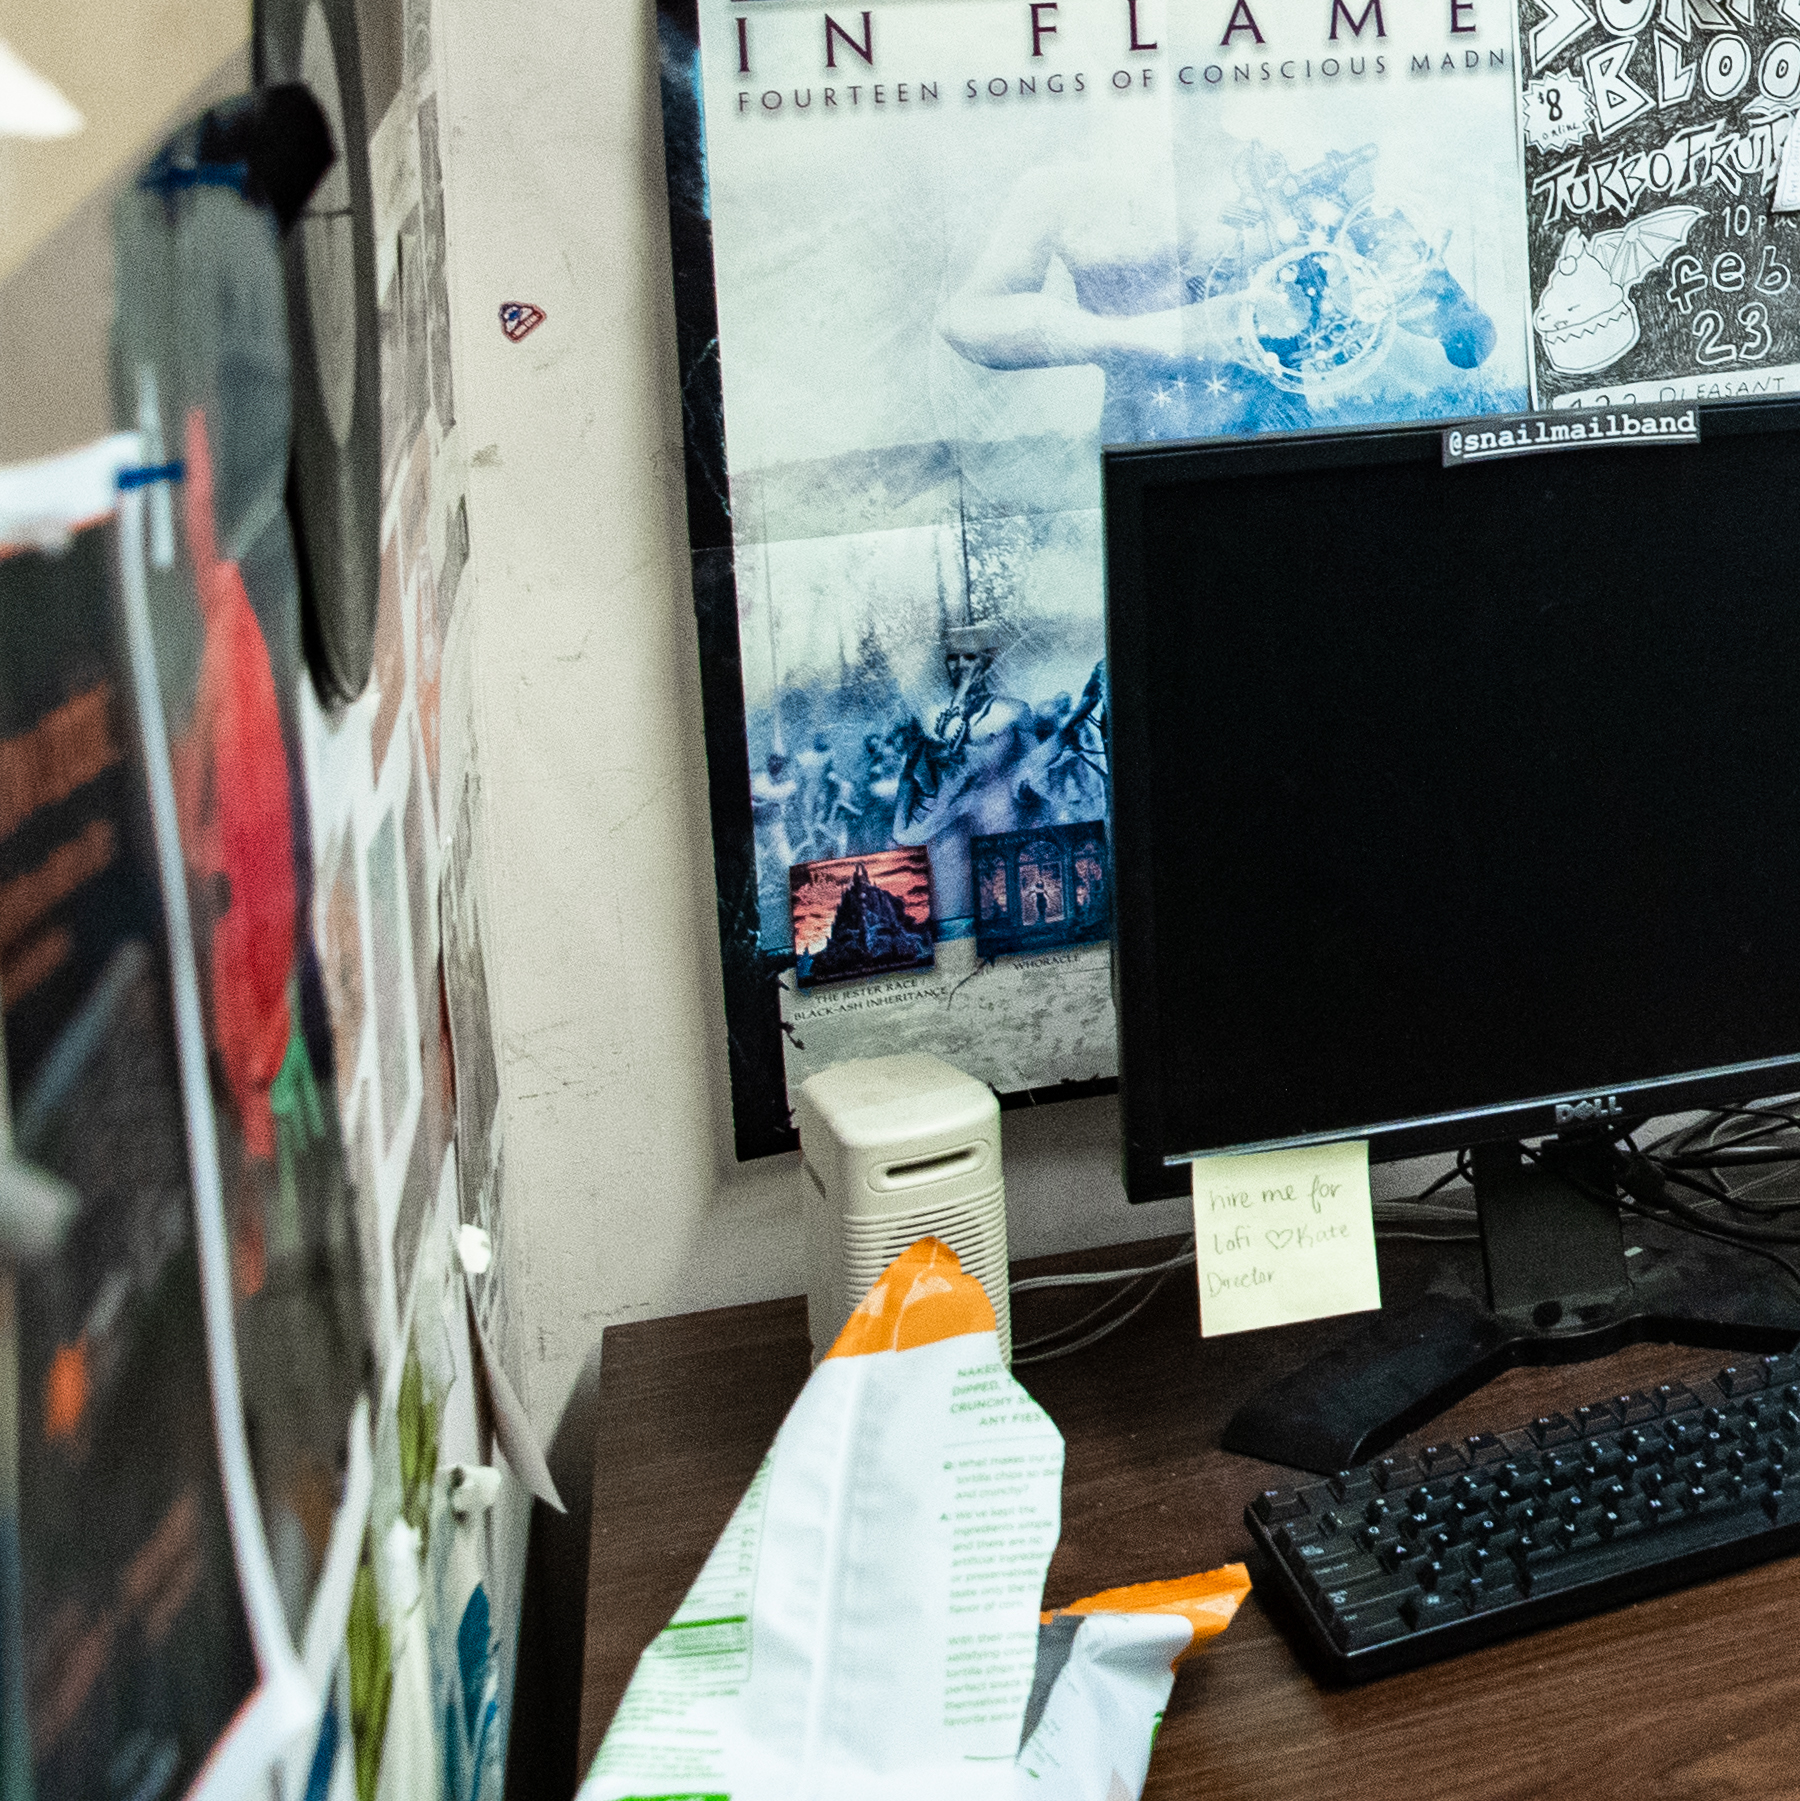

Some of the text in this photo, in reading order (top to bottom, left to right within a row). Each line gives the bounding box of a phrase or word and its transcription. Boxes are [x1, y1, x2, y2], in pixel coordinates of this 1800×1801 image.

[734, 10, 874, 74] IN
[737, 54, 1387, 114] FOURTEEN SONGS OF CONSCIOUS
[1721, 205, 1751, 238] 10
[1669, 247, 1791, 316] feb
[1693, 302, 1773, 366] 23
[1447, 409, 1698, 462] @snailmailband
[1555, 1096, 1623, 1126] DELL
[1209, 1174, 1342, 1214] hire me for
